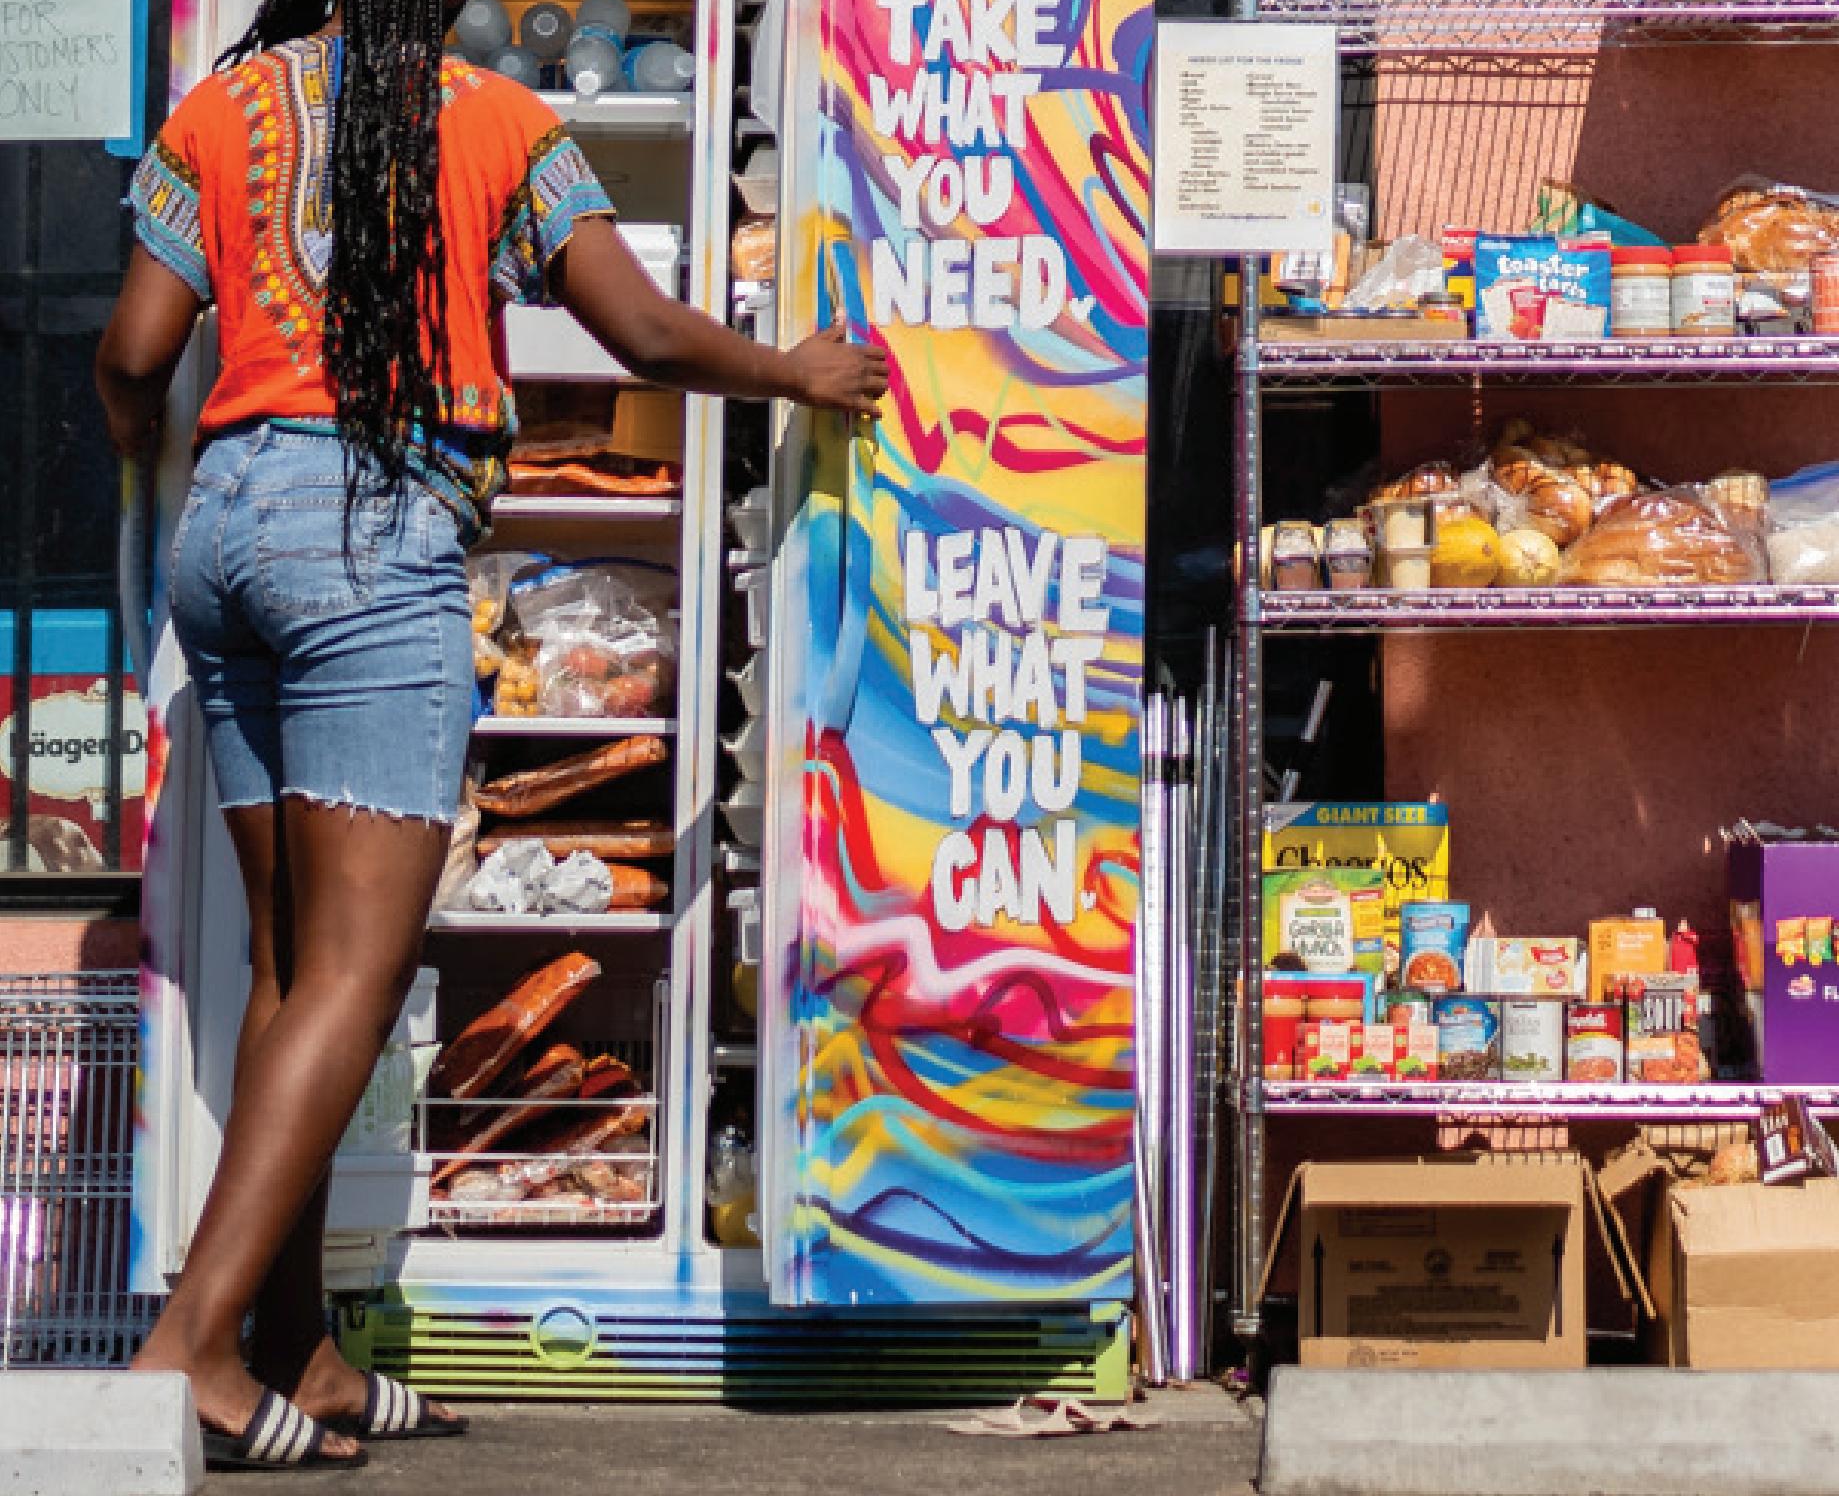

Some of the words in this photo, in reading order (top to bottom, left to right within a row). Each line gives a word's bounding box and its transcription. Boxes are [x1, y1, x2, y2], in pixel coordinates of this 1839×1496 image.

[3, 2, 63, 36] FOR
[0, 34, 119, 75] STOMERS
[0, 72, 80, 122] ONLY
[869, 67, 1042, 149] WHAT
[883, 154, 1013, 228] YOU
[1497, 253, 1590, 279] toaster
[904, 526, 1110, 633] LEAVE
[908, 624, 1105, 730] WHAT
[10, 729, 111, 764] äagen
[931, 728, 1081, 822] YOU
[1316, 806, 1379, 825] GIANT
[1383, 806, 1428, 825] SIZE
